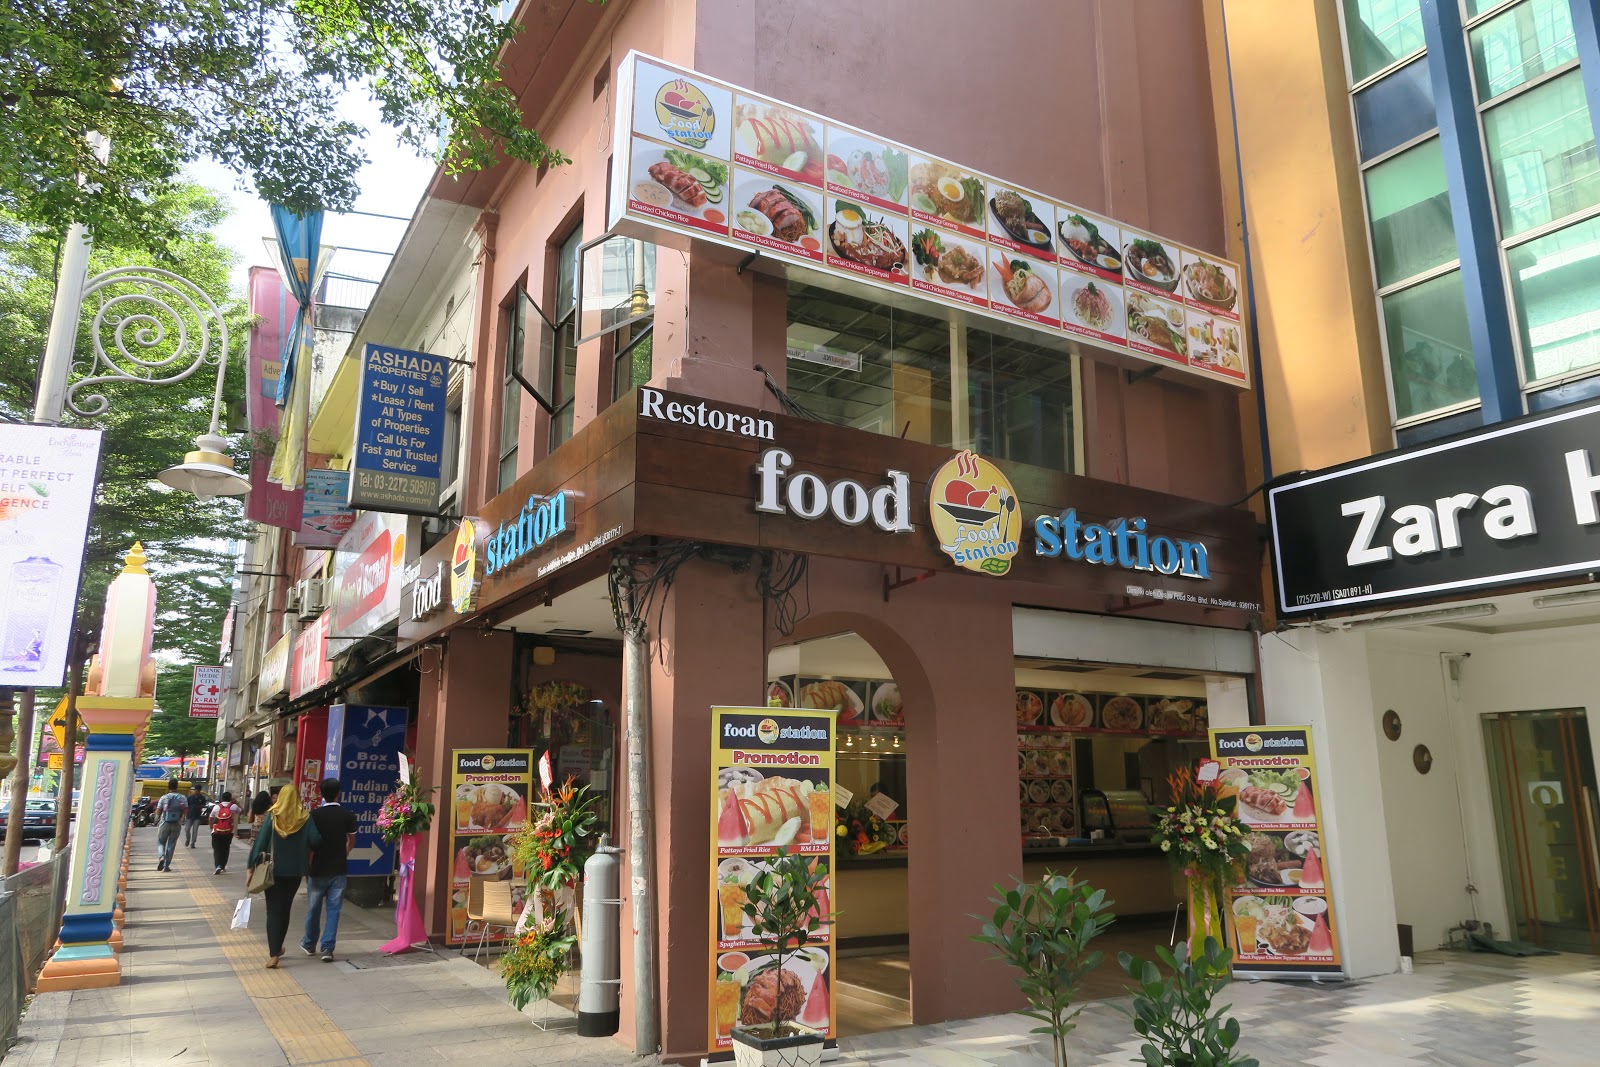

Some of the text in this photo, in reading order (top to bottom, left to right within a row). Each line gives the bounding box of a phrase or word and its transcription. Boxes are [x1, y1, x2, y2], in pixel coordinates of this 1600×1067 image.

[667, 128, 713, 140] station
[735, 154, 779, 173] Pattaya Fried Rice
[828, 183, 870, 201] Seafood Fried Rice
[631, 202, 690, 222] Roasted Chicken Rice
[913, 210, 929, 220] Special
[734, 231, 756, 241] Roasted
[756, 236, 769, 245] Duck
[790, 246, 811, 257] Noodles
[828, 257, 846, 266] Special
[845, 262, 864, 271] Chicken
[914, 281, 929, 289] Grilled
[929, 285, 946, 294] Chicken
[369, 350, 444, 376] ASHADA
[263, 364, 280, 376] Adve
[368, 363, 427, 381] PROPERTIES
[408, 385, 424, 397] Sell
[414, 399, 434, 412] Rent
[381, 406, 423, 422] All Types
[639, 387, 775, 440] Restoran
[371, 418, 430, 435] of Properties
[377, 432, 426, 449] Call Us For
[0, 454, 41, 465] RABLE
[362, 443, 438, 463] Fast and Trusted
[382, 458, 417, 473] Service
[12, 469, 74, 482] PERFECT
[359, 472, 373, 488] Tel:
[1, 484, 26, 493] ELF
[1, 498, 50, 510] GENCE
[360, 490, 432, 506] www.ashada.com.my
[755, 449, 1212, 580] food station
[1341, 484, 1538, 566] Zara
[411, 561, 442, 620] food
[485, 490, 567, 576] station
[954, 539, 1018, 564] station
[1173, 592, 1186, 601] Food
[724, 723, 828, 740] food station
[1219, 736, 1305, 749] food station
[357, 752, 388, 761] Box
[460, 757, 527, 767] food station
[733, 750, 820, 765] Promotion
[1227, 756, 1300, 767] Promotion
[325, 762, 339, 771] Office
[346, 760, 397, 771] Office
[465, 773, 521, 783] Promotion
[352, 779, 388, 791] Indian
[341, 791, 365, 803] Live
[353, 810, 378, 822] ndia
[719, 846, 742, 855] Pattaya
[719, 940, 746, 949] Spaghetti
